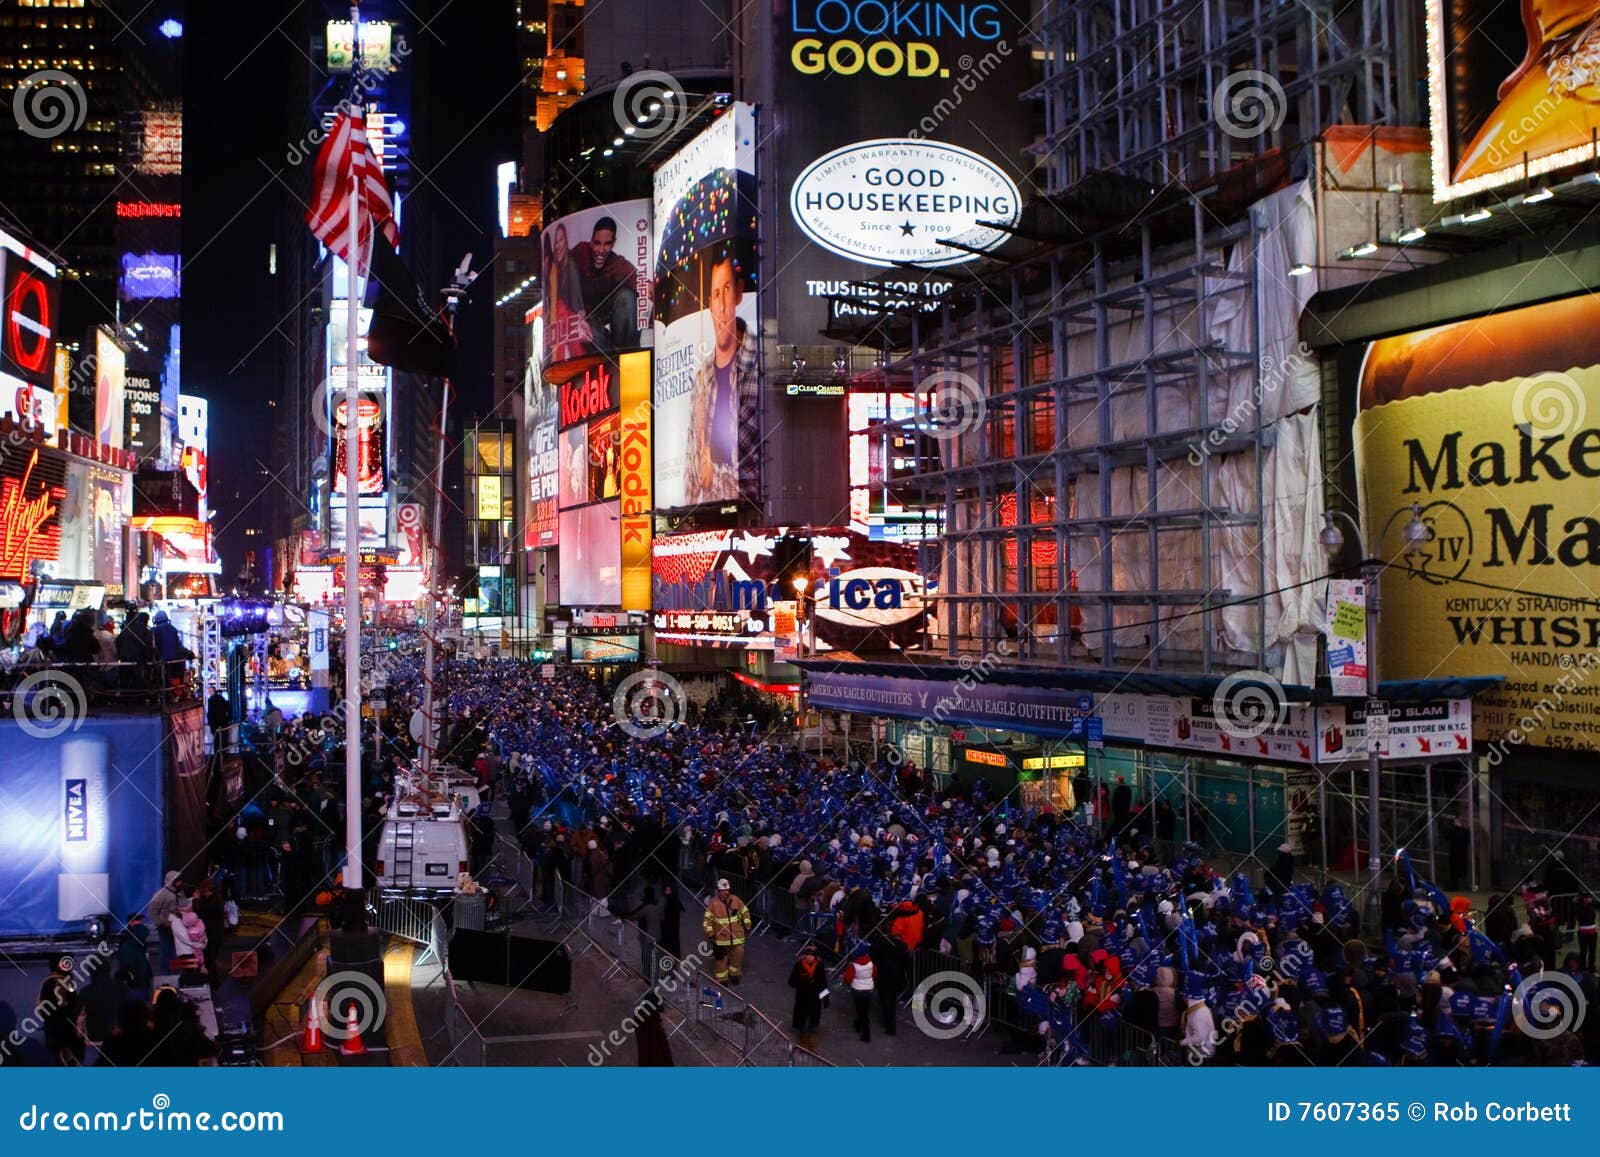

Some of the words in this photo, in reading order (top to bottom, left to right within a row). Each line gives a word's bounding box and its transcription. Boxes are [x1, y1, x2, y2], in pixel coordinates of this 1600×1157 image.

[792, 0, 1001, 40] LOOKING
[791, 38, 949, 78] GOOD.
[815, 155, 857, 182] LIMITED
[860, 149, 921, 160] WARRANTY
[938, 152, 1002, 188] CONSUMERS
[865, 168, 945, 187] GOOD
[805, 191, 1010, 215] HOUSEKEEPING
[812, 216, 883, 254] REPLACEMENT
[860, 220, 893, 231] Since
[924, 225, 952, 233] 1909
[636, 235, 649, 331] SOUTHPOLE
[806, 280, 880, 297] TRUSTED
[655, 344, 695, 381] BEDTIME
[561, 363, 611, 427] Kodak
[655, 367, 695, 408] STORIES
[621, 421, 649, 545] Kodak
[3, 448, 57, 584] Virgin
[1438, 537, 1465, 562] IV
[1445, 597, 1512, 612] KENTUCKY
[1517, 597, 1588, 612] STRAIGHT
[748, 617, 764, 632] to
[809, 683, 843, 699] AMERICAN
[843, 687, 866, 701] EAGLE
[866, 690, 913, 707] OUTFITTERS
[1504, 680, 1537, 697] aged
[985, 700, 1018, 717] EAGLE
[1405, 706, 1443, 717] SLAM
[1277, 728, 1286, 737] IN
[1345, 728, 1368, 737] RATE
[1412, 724, 1435, 734] STORE
[1437, 723, 1446, 732] IN
[68, 782, 84, 838] NIVEA
